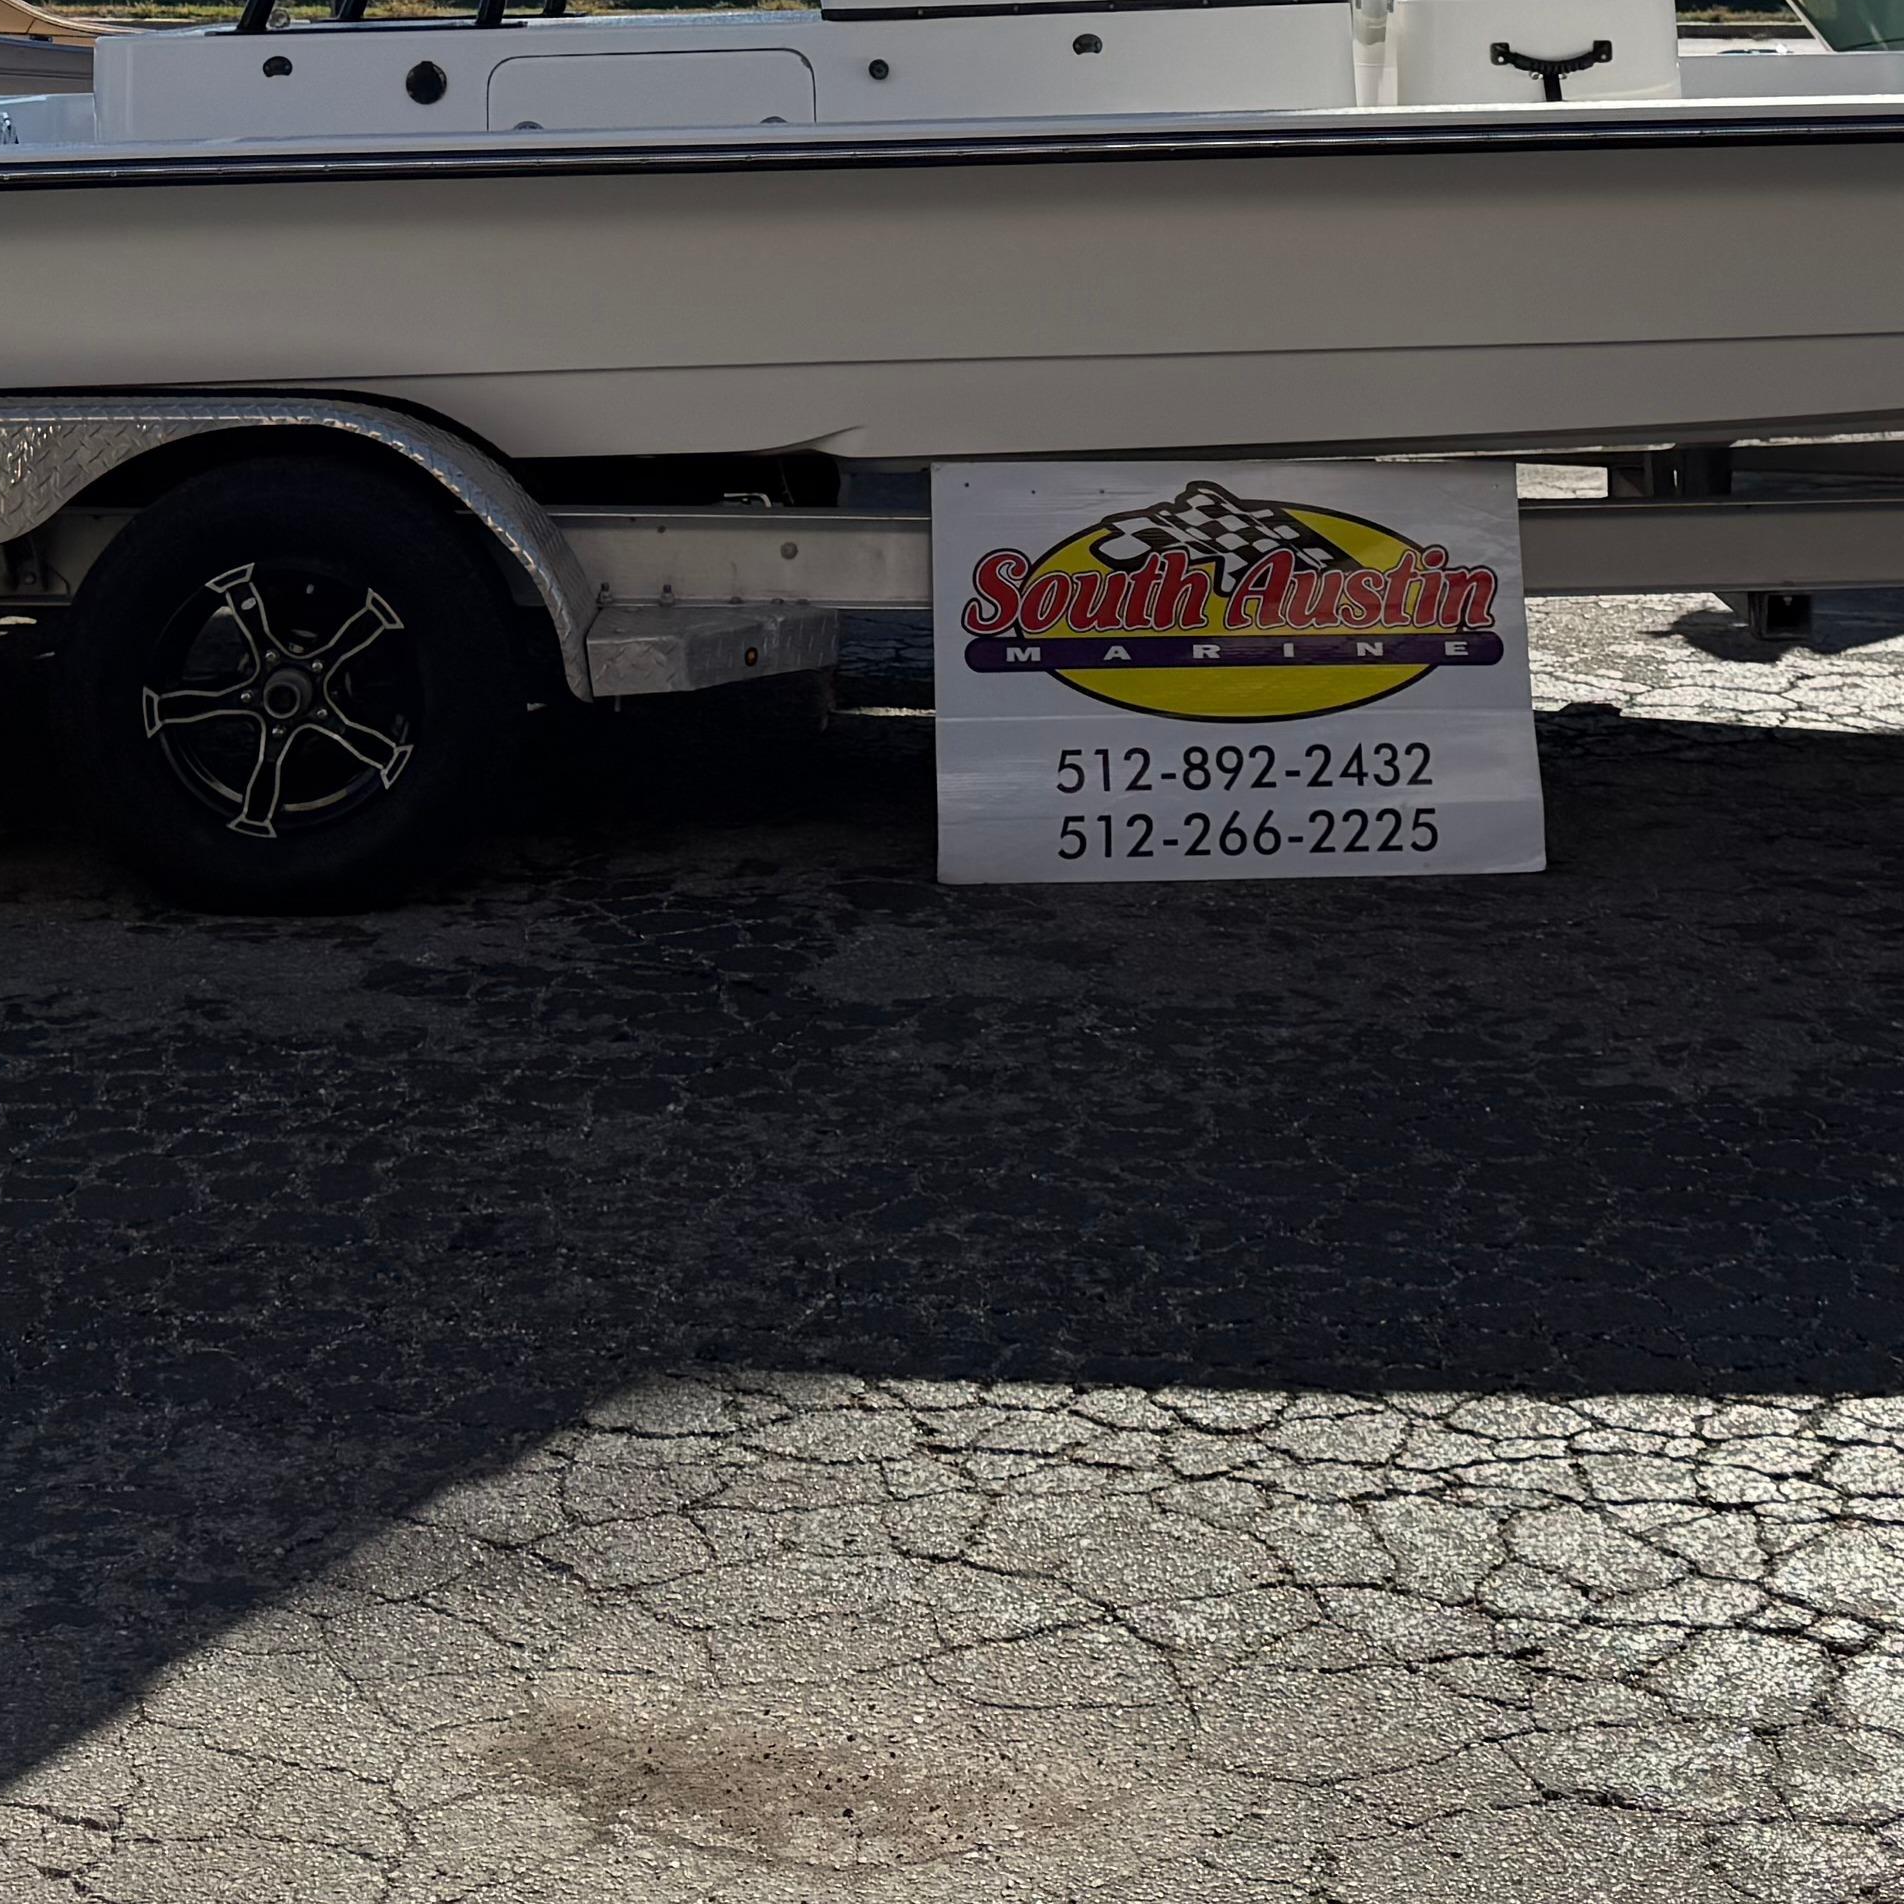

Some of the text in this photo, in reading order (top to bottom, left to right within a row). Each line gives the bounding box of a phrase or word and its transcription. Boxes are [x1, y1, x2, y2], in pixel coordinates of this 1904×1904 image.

[964, 546, 1498, 634] South Austin
[1005, 640, 1469, 663] MARINE
[1055, 741, 1434, 794] 512-892-2432
[1057, 807, 1439, 860] 512-266-2225
